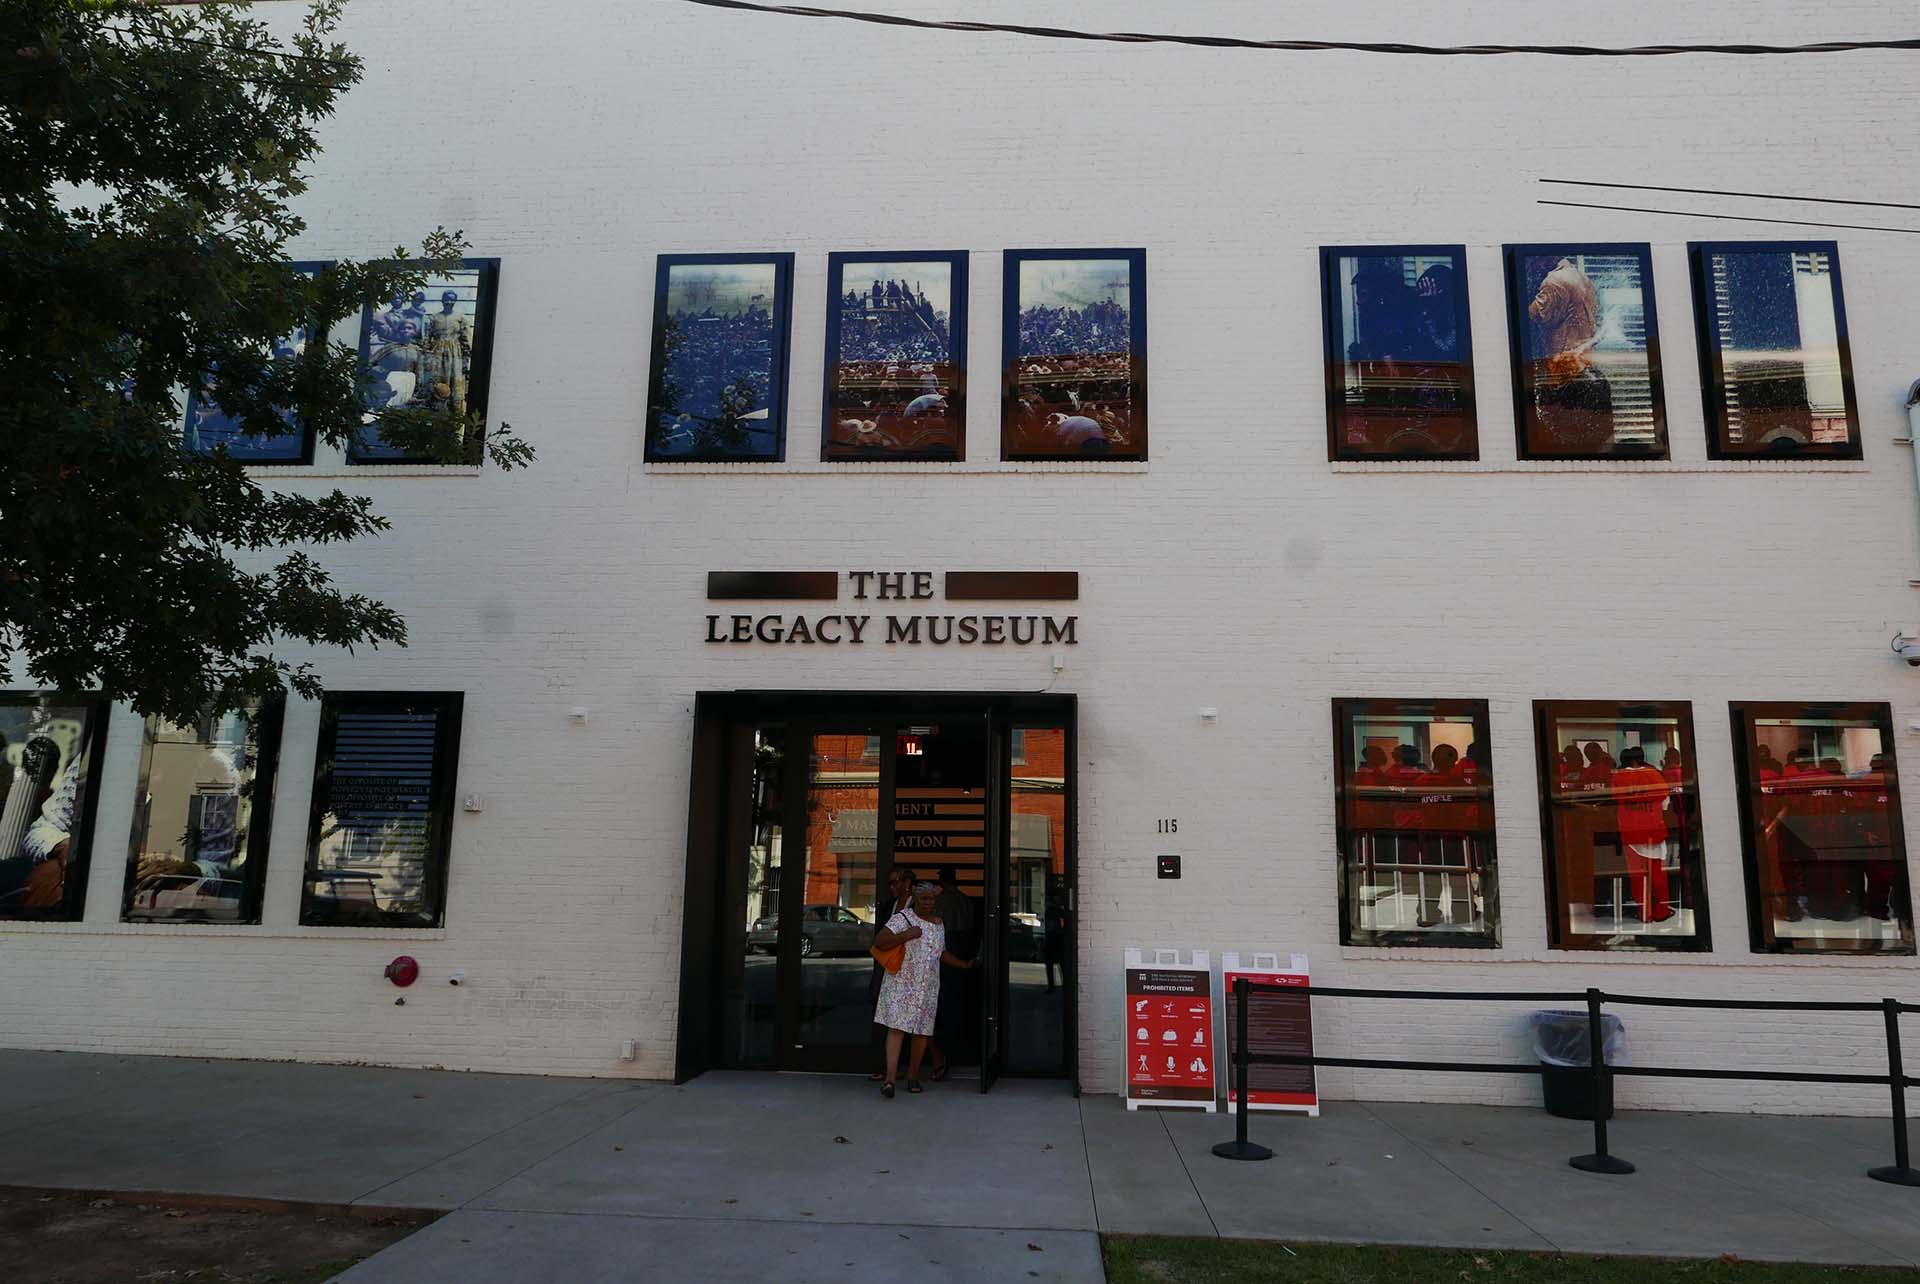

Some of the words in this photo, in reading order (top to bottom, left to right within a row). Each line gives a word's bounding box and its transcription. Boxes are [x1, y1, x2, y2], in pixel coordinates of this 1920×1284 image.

[849, 570, 934, 600] THE
[705, 615, 871, 644] LEGACY
[885, 615, 1079, 645] MUSEUM
[1158, 818, 1178, 833] 115
[1143, 984, 1176, 992] PROHIBITED
